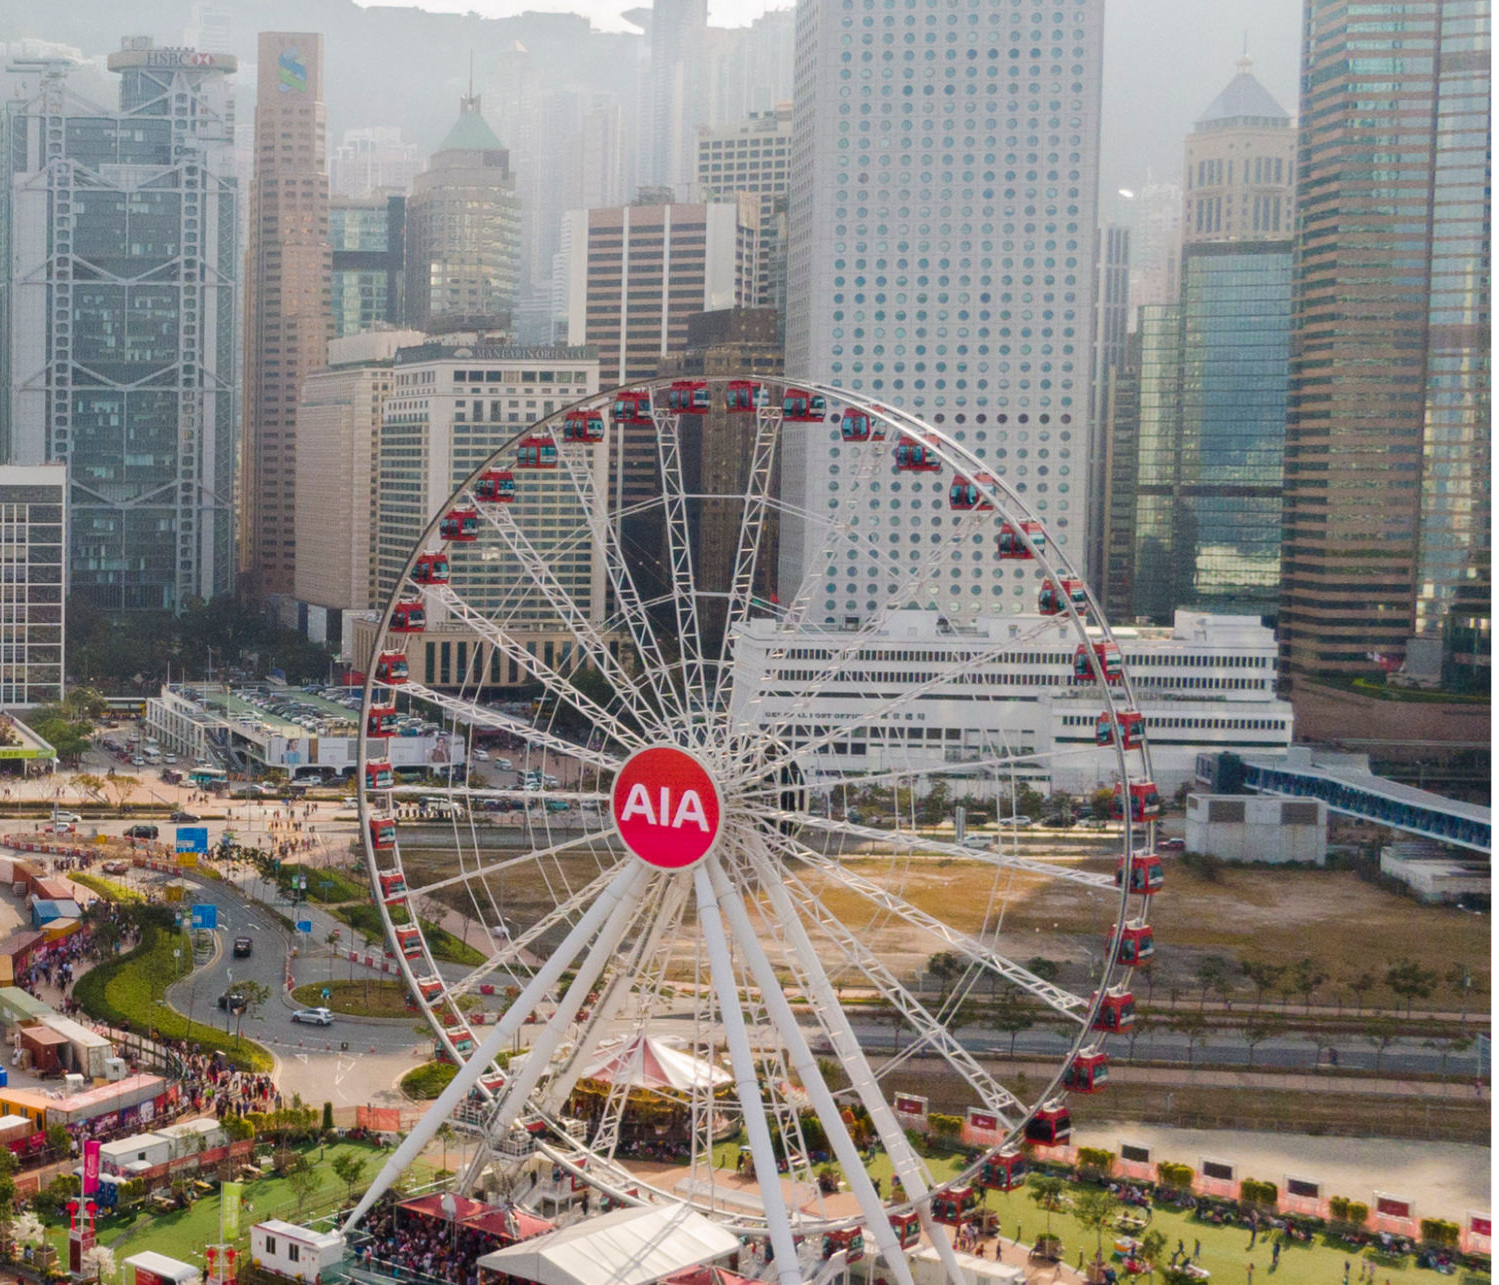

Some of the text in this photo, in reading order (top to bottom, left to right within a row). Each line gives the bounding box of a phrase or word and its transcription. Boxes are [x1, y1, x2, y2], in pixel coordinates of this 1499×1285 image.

[147, 52, 190, 65] HSBC
[477, 349, 588, 359] MANDARIN ORIENTAL
[620, 783, 710, 833] AIA
